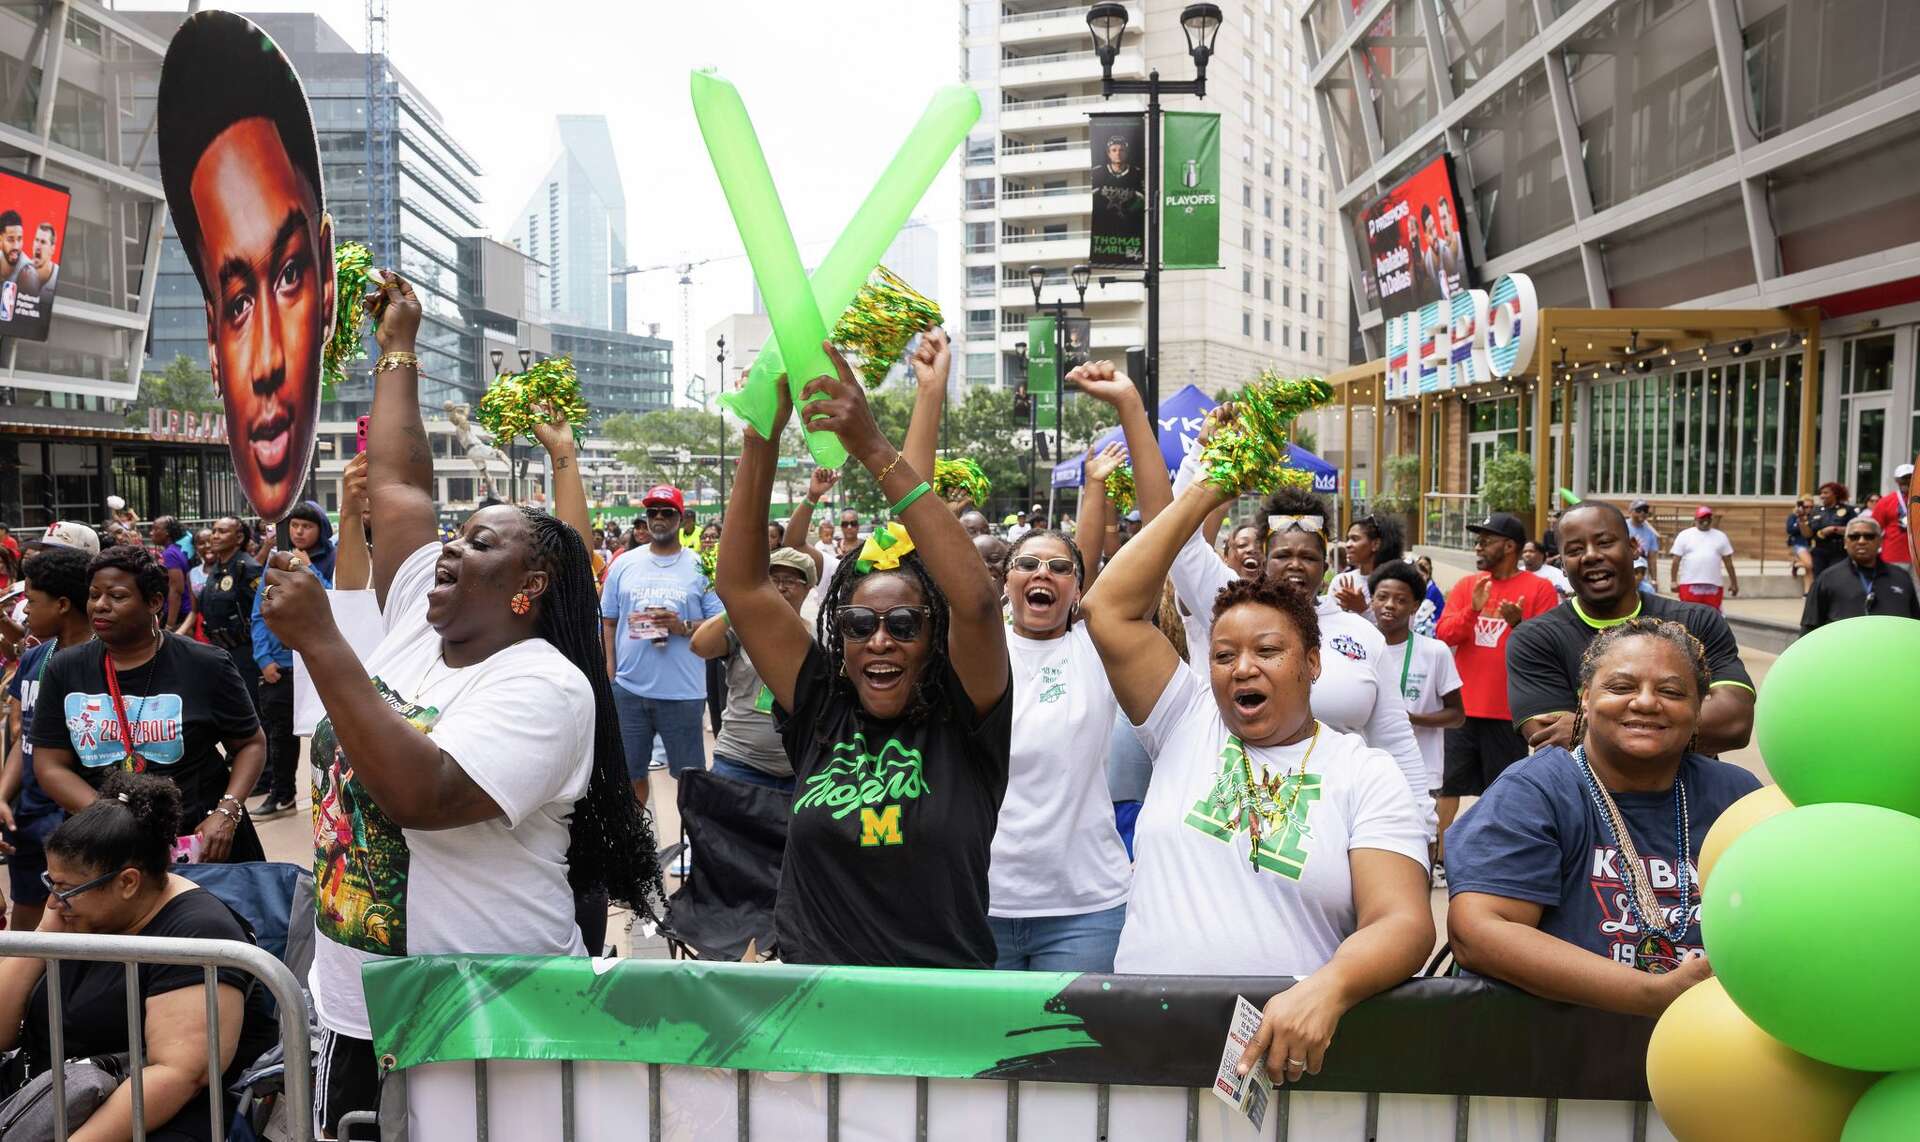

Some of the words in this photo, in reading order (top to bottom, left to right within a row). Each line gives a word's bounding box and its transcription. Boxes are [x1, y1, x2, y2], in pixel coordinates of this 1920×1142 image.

[1166, 194, 1216, 205] PLAYOFFS
[1093, 235, 1141, 246] THOMAS
[1377, 246, 1410, 278] Available
[1386, 270, 1412, 294] Dallas
[1385, 273, 1538, 400] HERO
[860, 805, 903, 847] M
[1613, 943, 1636, 967] 19
